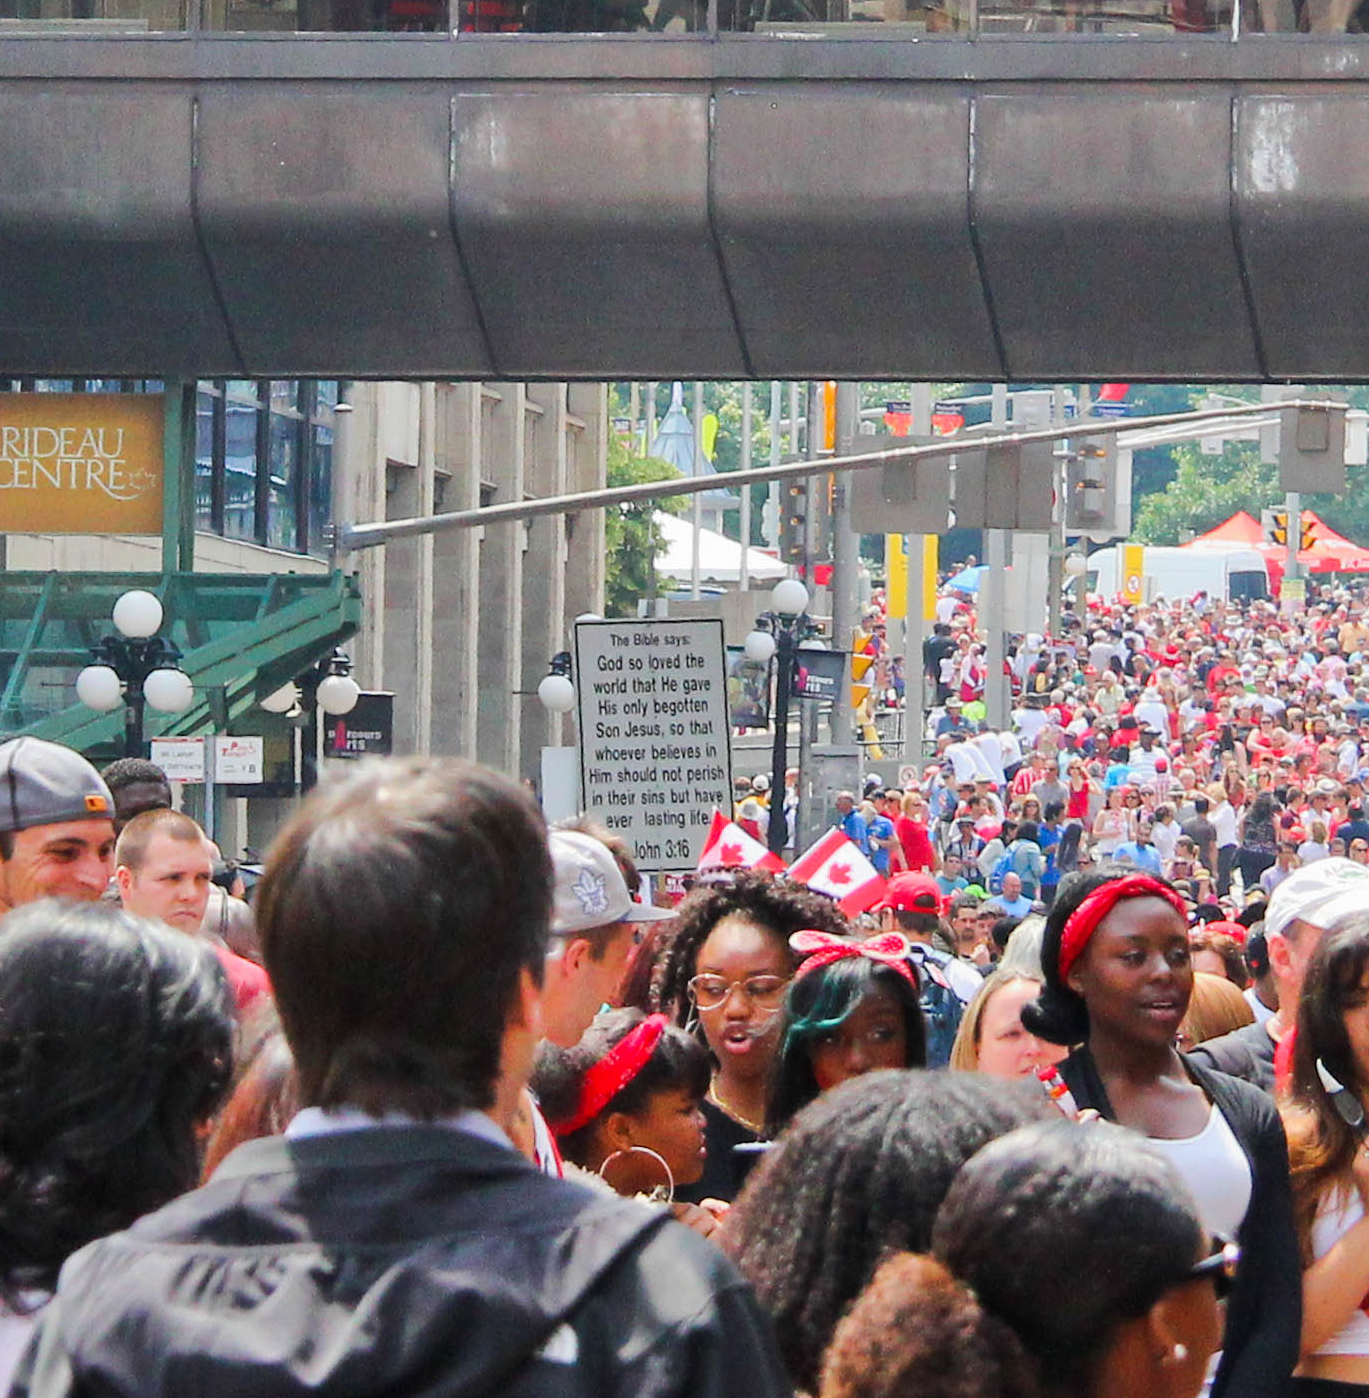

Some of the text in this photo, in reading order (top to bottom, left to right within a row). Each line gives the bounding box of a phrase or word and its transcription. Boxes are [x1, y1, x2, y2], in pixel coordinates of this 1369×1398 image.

[1, 426, 124, 459] RIDEAU
[610, 634, 629, 646] The
[633, 633, 660, 646] Bible
[597, 652, 705, 671] God so loved the
[593, 676, 711, 695] world that He gave
[598, 697, 709, 717] His only begotten
[596, 720, 713, 739] Son Jesus, so that
[595, 742, 717, 761] whoever believes in
[589, 764, 724, 784] Him should not perish
[592, 787, 723, 806] in their sins but have
[606, 815, 633, 828] ever
[644, 810, 686, 829] lasting
[633, 839, 690, 859] John 3:16
